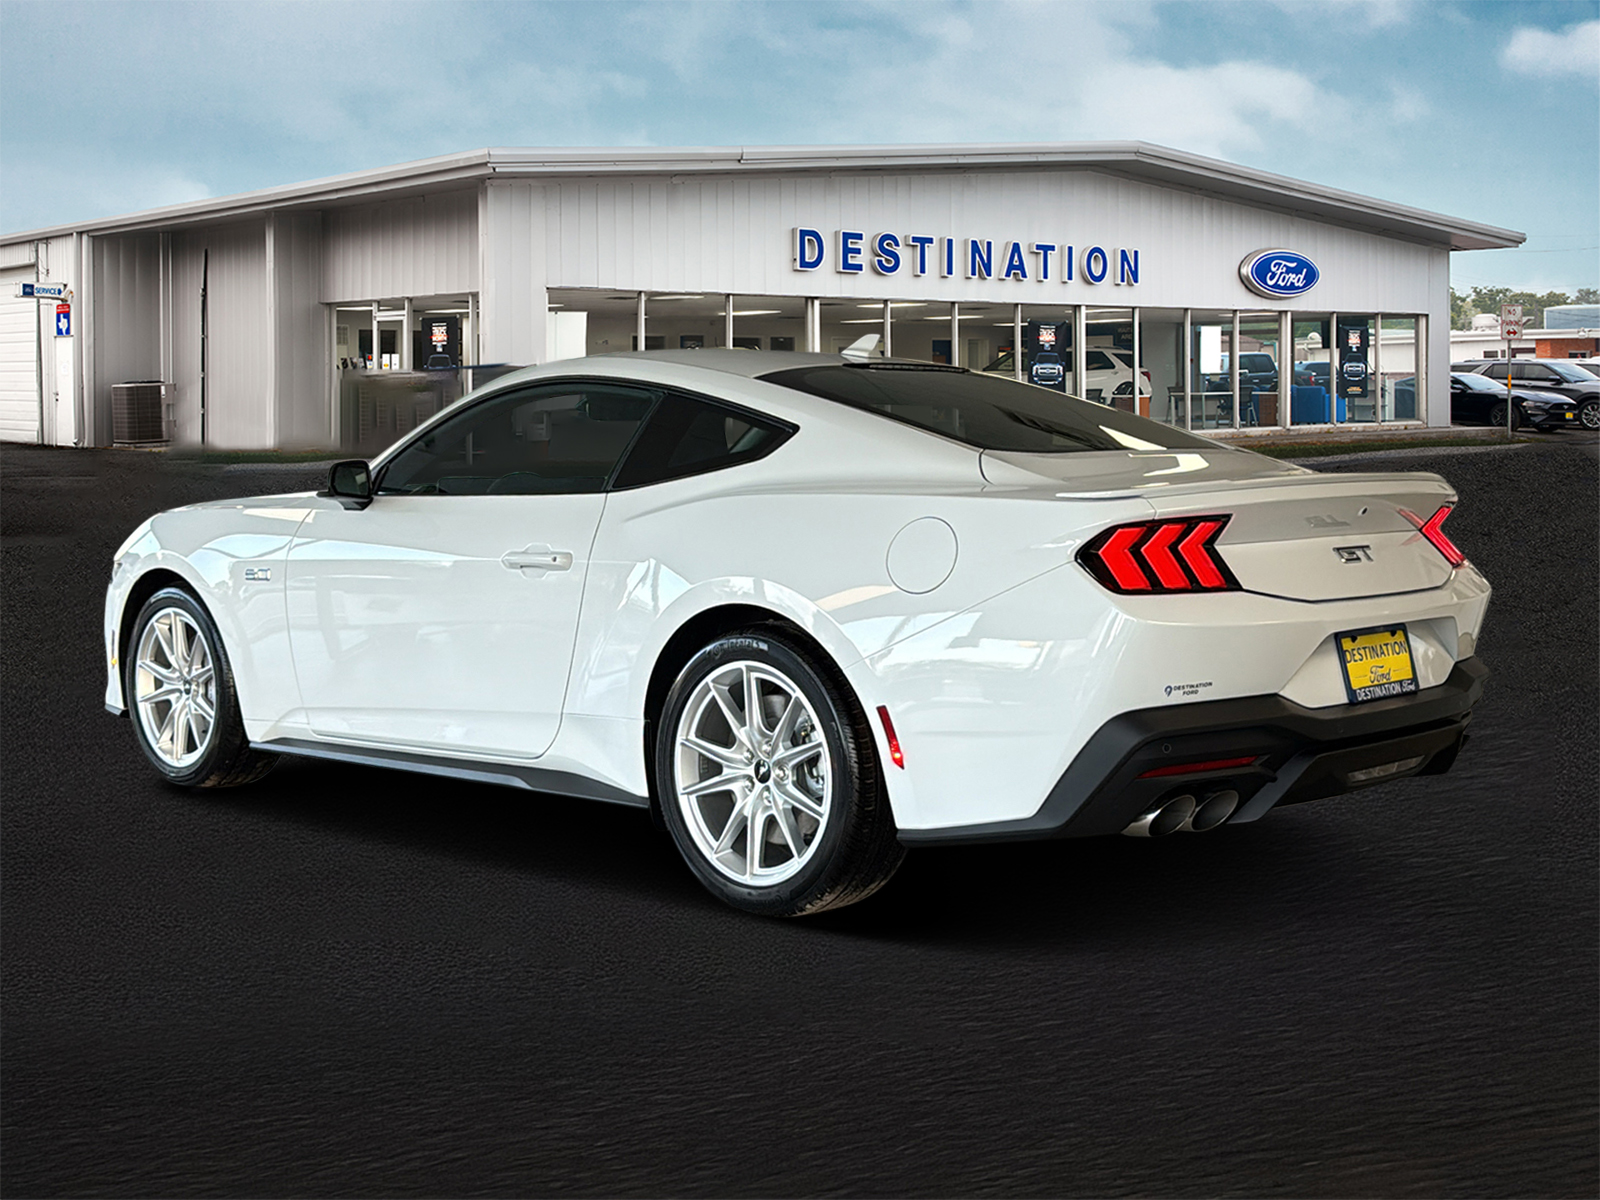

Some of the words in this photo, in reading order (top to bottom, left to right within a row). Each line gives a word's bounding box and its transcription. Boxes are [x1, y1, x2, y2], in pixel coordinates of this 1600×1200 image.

[793, 227, 1141, 285] DESTINATION
[1266, 259, 1307, 287] Ford
[35, 286, 57, 295] SERVICE
[1507, 308, 1517, 316] NO
[1332, 545, 1374, 564] GT
[1344, 640, 1408, 664] DESTINATION
[1369, 664, 1392, 684] Ford
[1173, 681, 1213, 691] DESTINATION
[1356, 682, 1402, 701] DESTINATION
[1401, 680, 1416, 693] Ford
